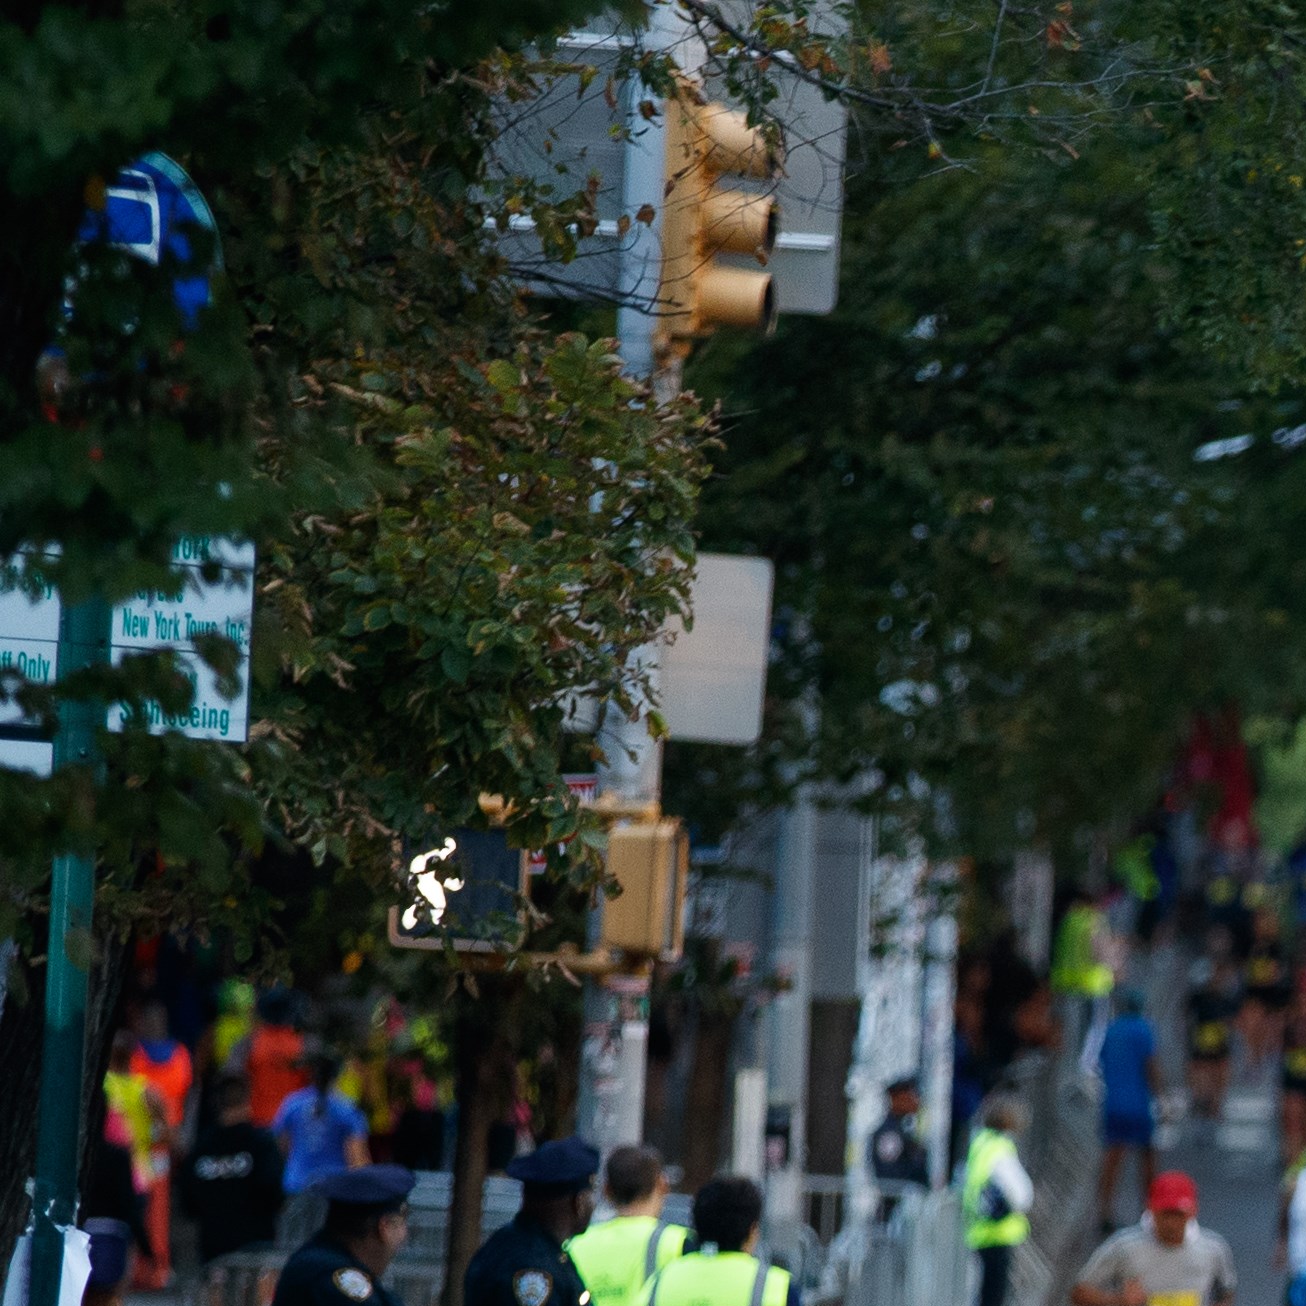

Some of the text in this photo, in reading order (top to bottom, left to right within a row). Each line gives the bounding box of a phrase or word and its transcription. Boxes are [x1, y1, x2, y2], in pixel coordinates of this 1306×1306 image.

[122, 607, 150, 638] New
[154, 610, 181, 641] York
[17, 651, 51, 682] Only
